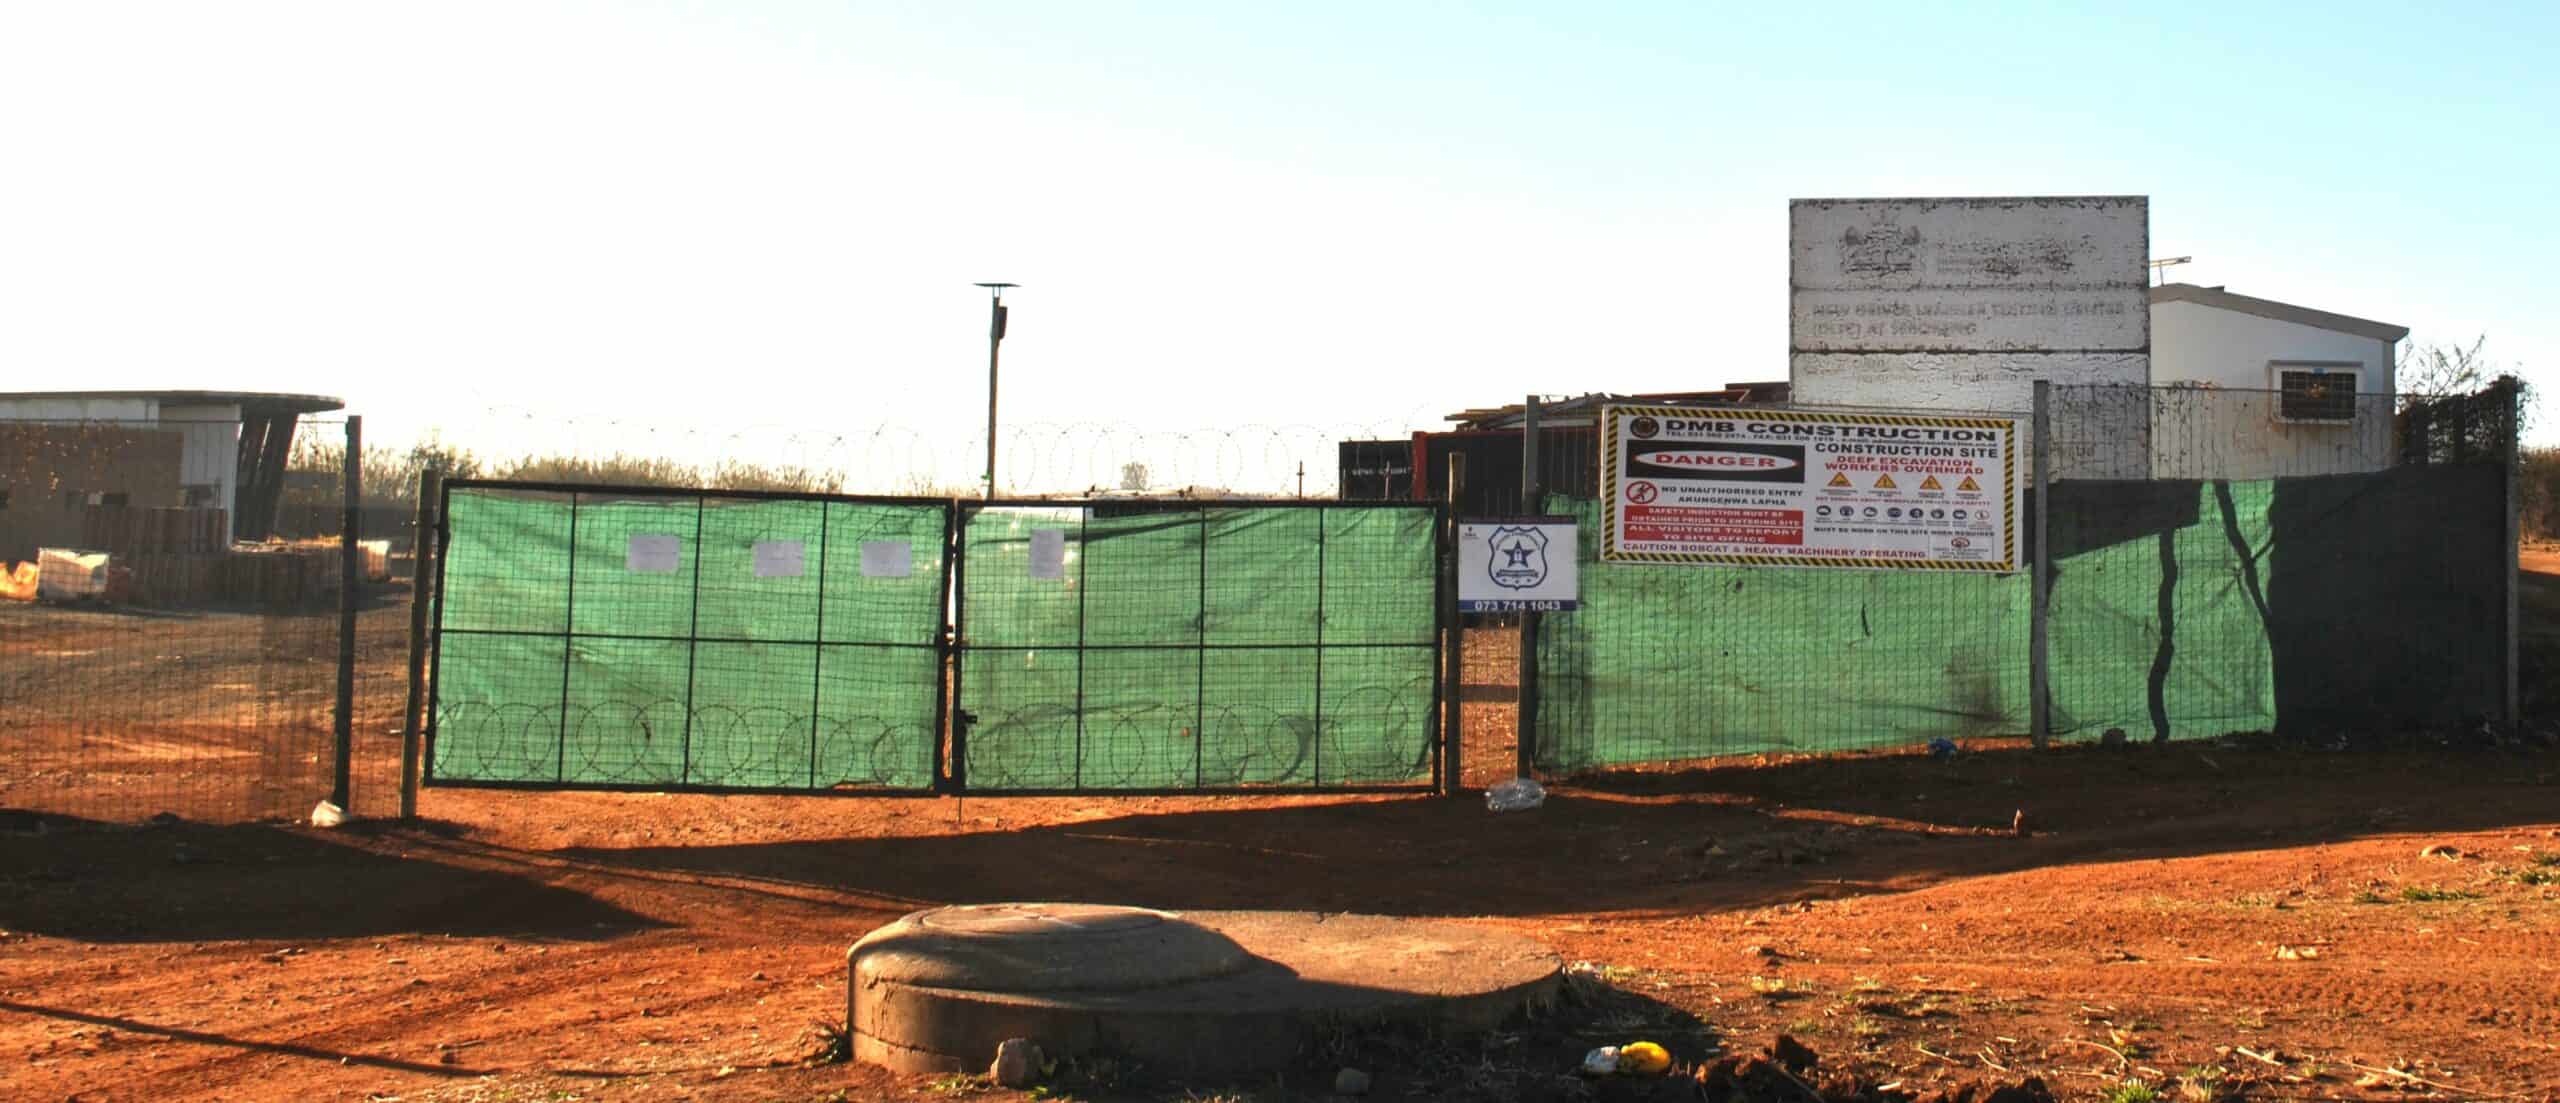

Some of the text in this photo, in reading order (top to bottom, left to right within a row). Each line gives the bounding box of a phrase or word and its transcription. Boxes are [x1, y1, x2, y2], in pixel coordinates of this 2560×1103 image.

[1666, 420, 1996, 441] DMB CONSTRUCTION
[1815, 443, 1954, 457] CONSTRUCTION
[1960, 448, 1998, 458] SITE
[1656, 454, 1776, 467] DANGER
[1880, 457, 1973, 466] EXCAVATION
[1825, 463, 1984, 474] WORKERS OVERHEAD
[1680, 487, 1764, 496] UNAUTHORISED
[1687, 508, 1740, 516] INDUCTION
[1729, 518, 1777, 526] ENTERING
[1746, 528, 1798, 536] REPORT
[1718, 536, 1766, 544] OFFICE
[1681, 544, 1729, 552] BOBCAT
[1744, 546, 1782, 554] HEAVY
[1787, 547, 1856, 556] MACHINERY
[1860, 550, 1926, 558] OPERATING
[1474, 601, 1560, 610] 073 714 1043
